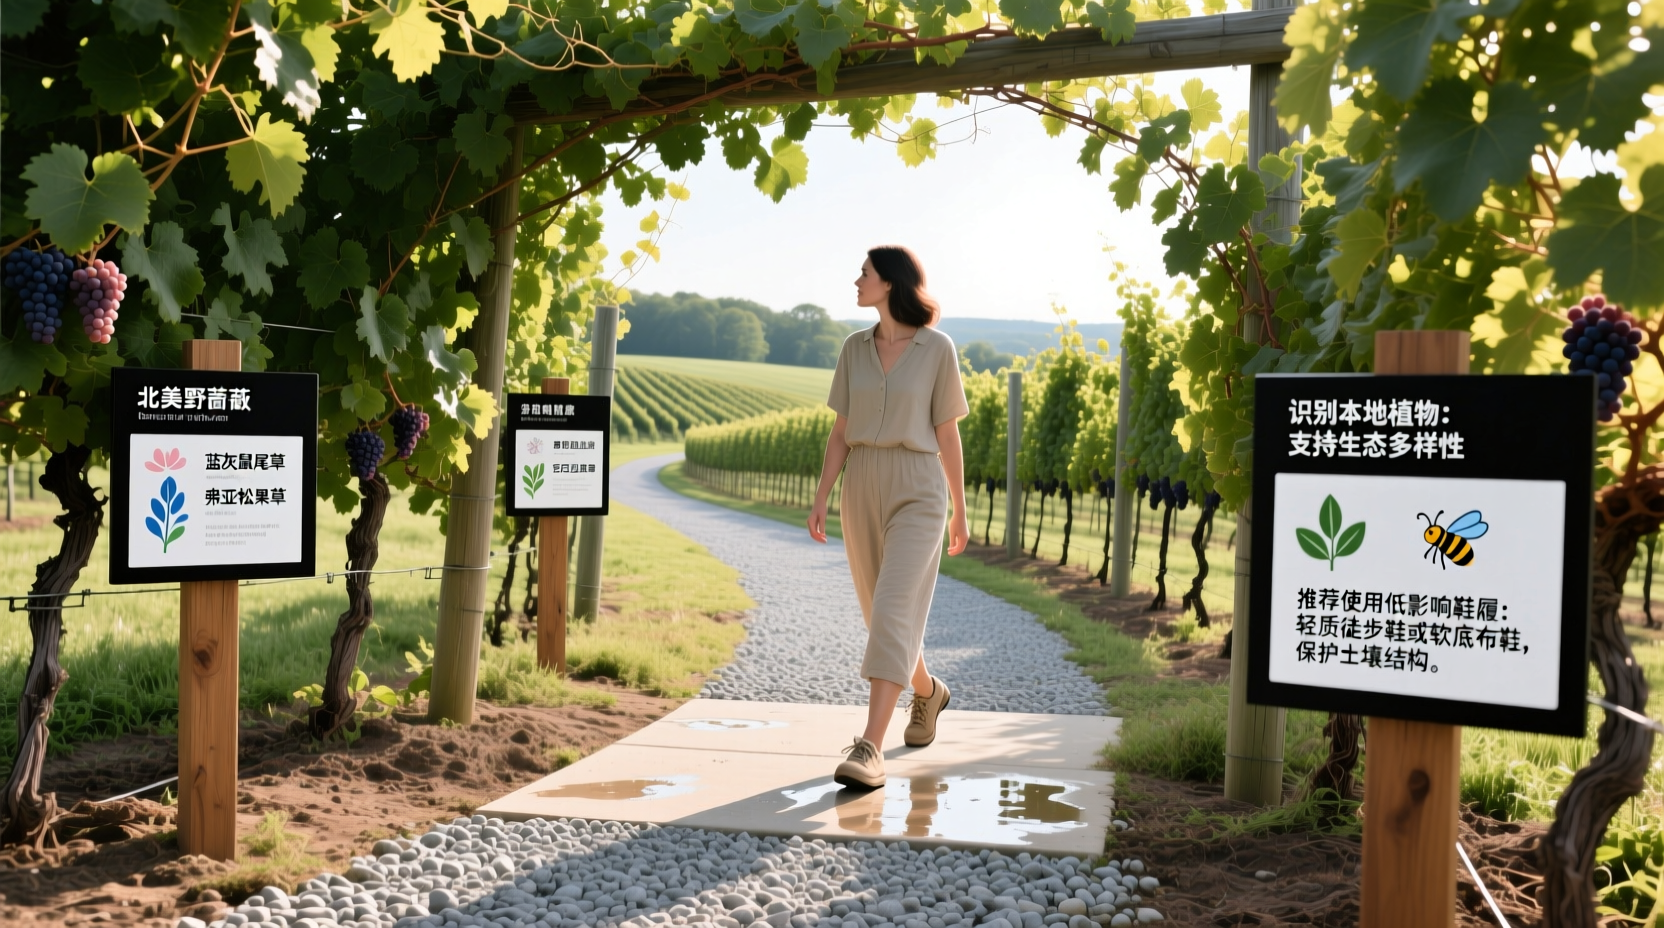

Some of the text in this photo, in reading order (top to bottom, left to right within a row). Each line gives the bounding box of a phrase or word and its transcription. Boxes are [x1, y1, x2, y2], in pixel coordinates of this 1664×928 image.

[1288, 398, 1450, 427] 识别本地植物：
[1288, 430, 1465, 460] 支持生态多样性
[1296, 640, 1439, 674] 保护土壤结构。
